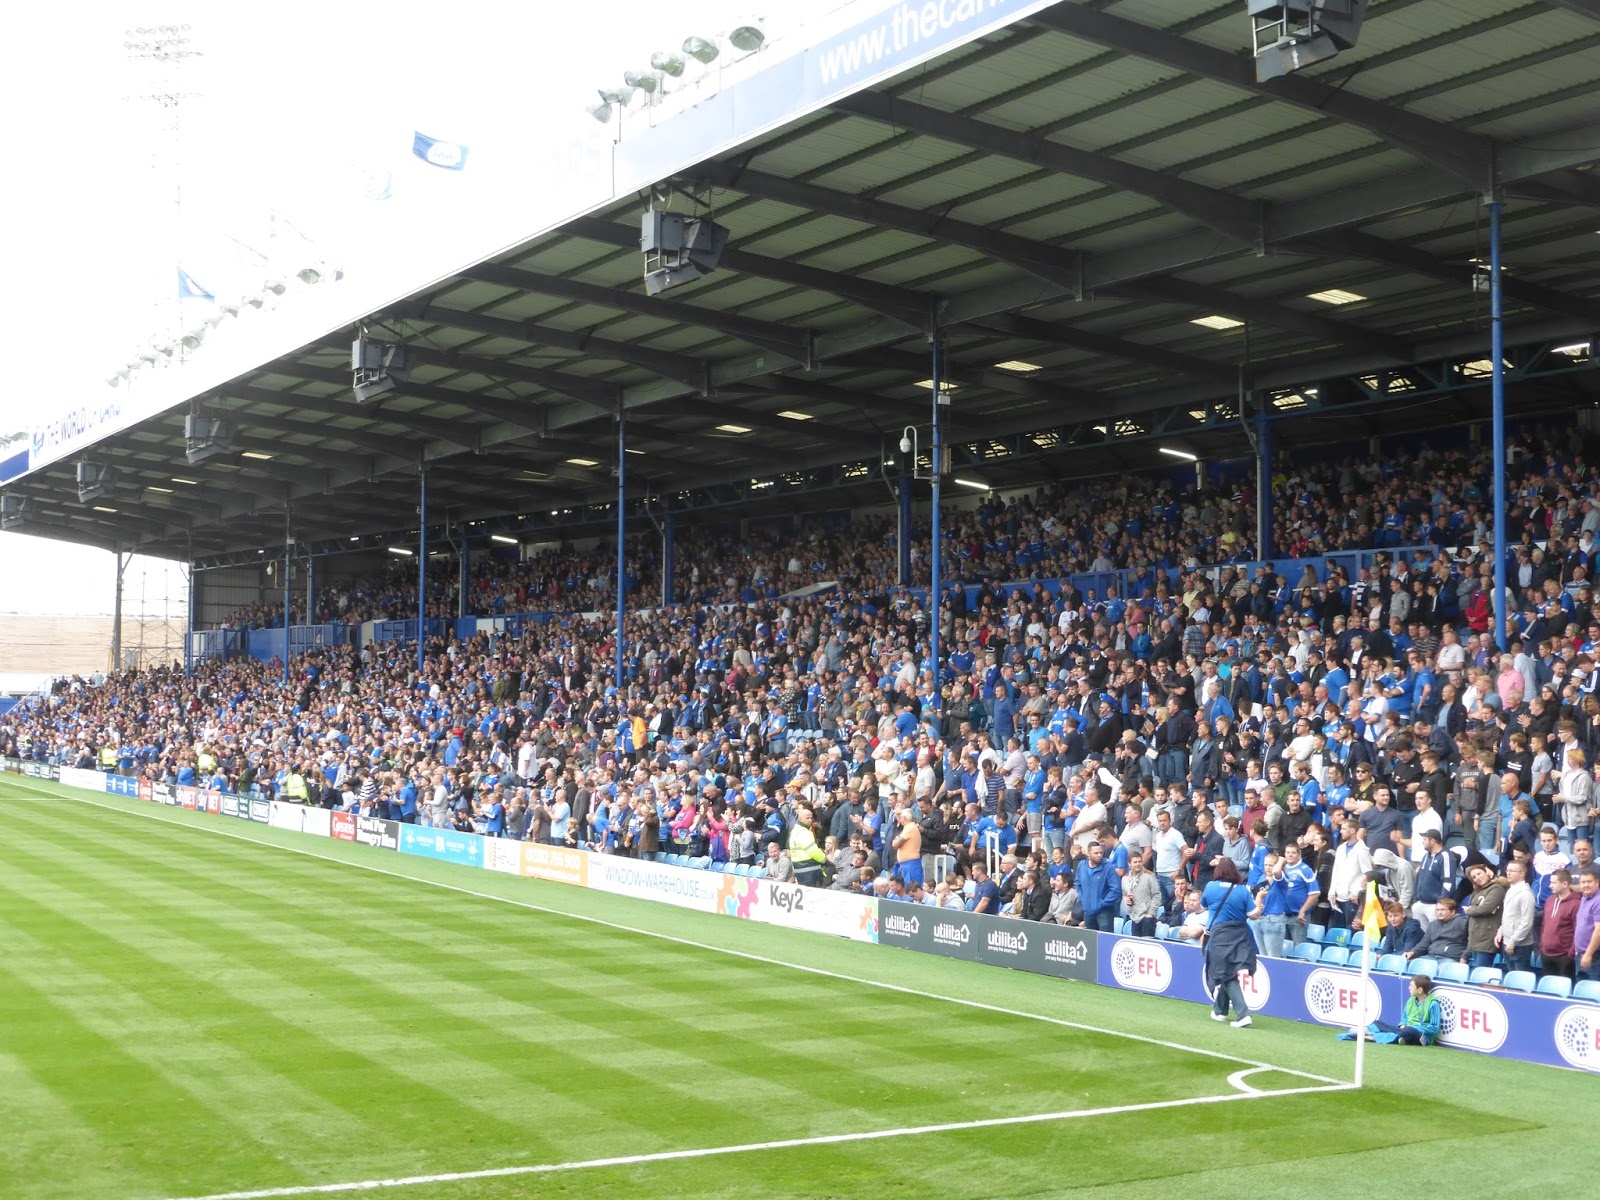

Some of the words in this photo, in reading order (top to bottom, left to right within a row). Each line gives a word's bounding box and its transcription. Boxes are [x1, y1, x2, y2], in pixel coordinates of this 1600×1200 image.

[819, 0, 1004, 84] www.theca
[885, 915, 911, 932] utilita
[934, 923, 960, 941] utilita
[988, 930, 1018, 949] utilita
[1045, 939, 1077, 960] utilita
[1138, 957, 1162, 977] EFL
[1236, 972, 1258, 993] FL
[1461, 1008, 1492, 1033] EFL
